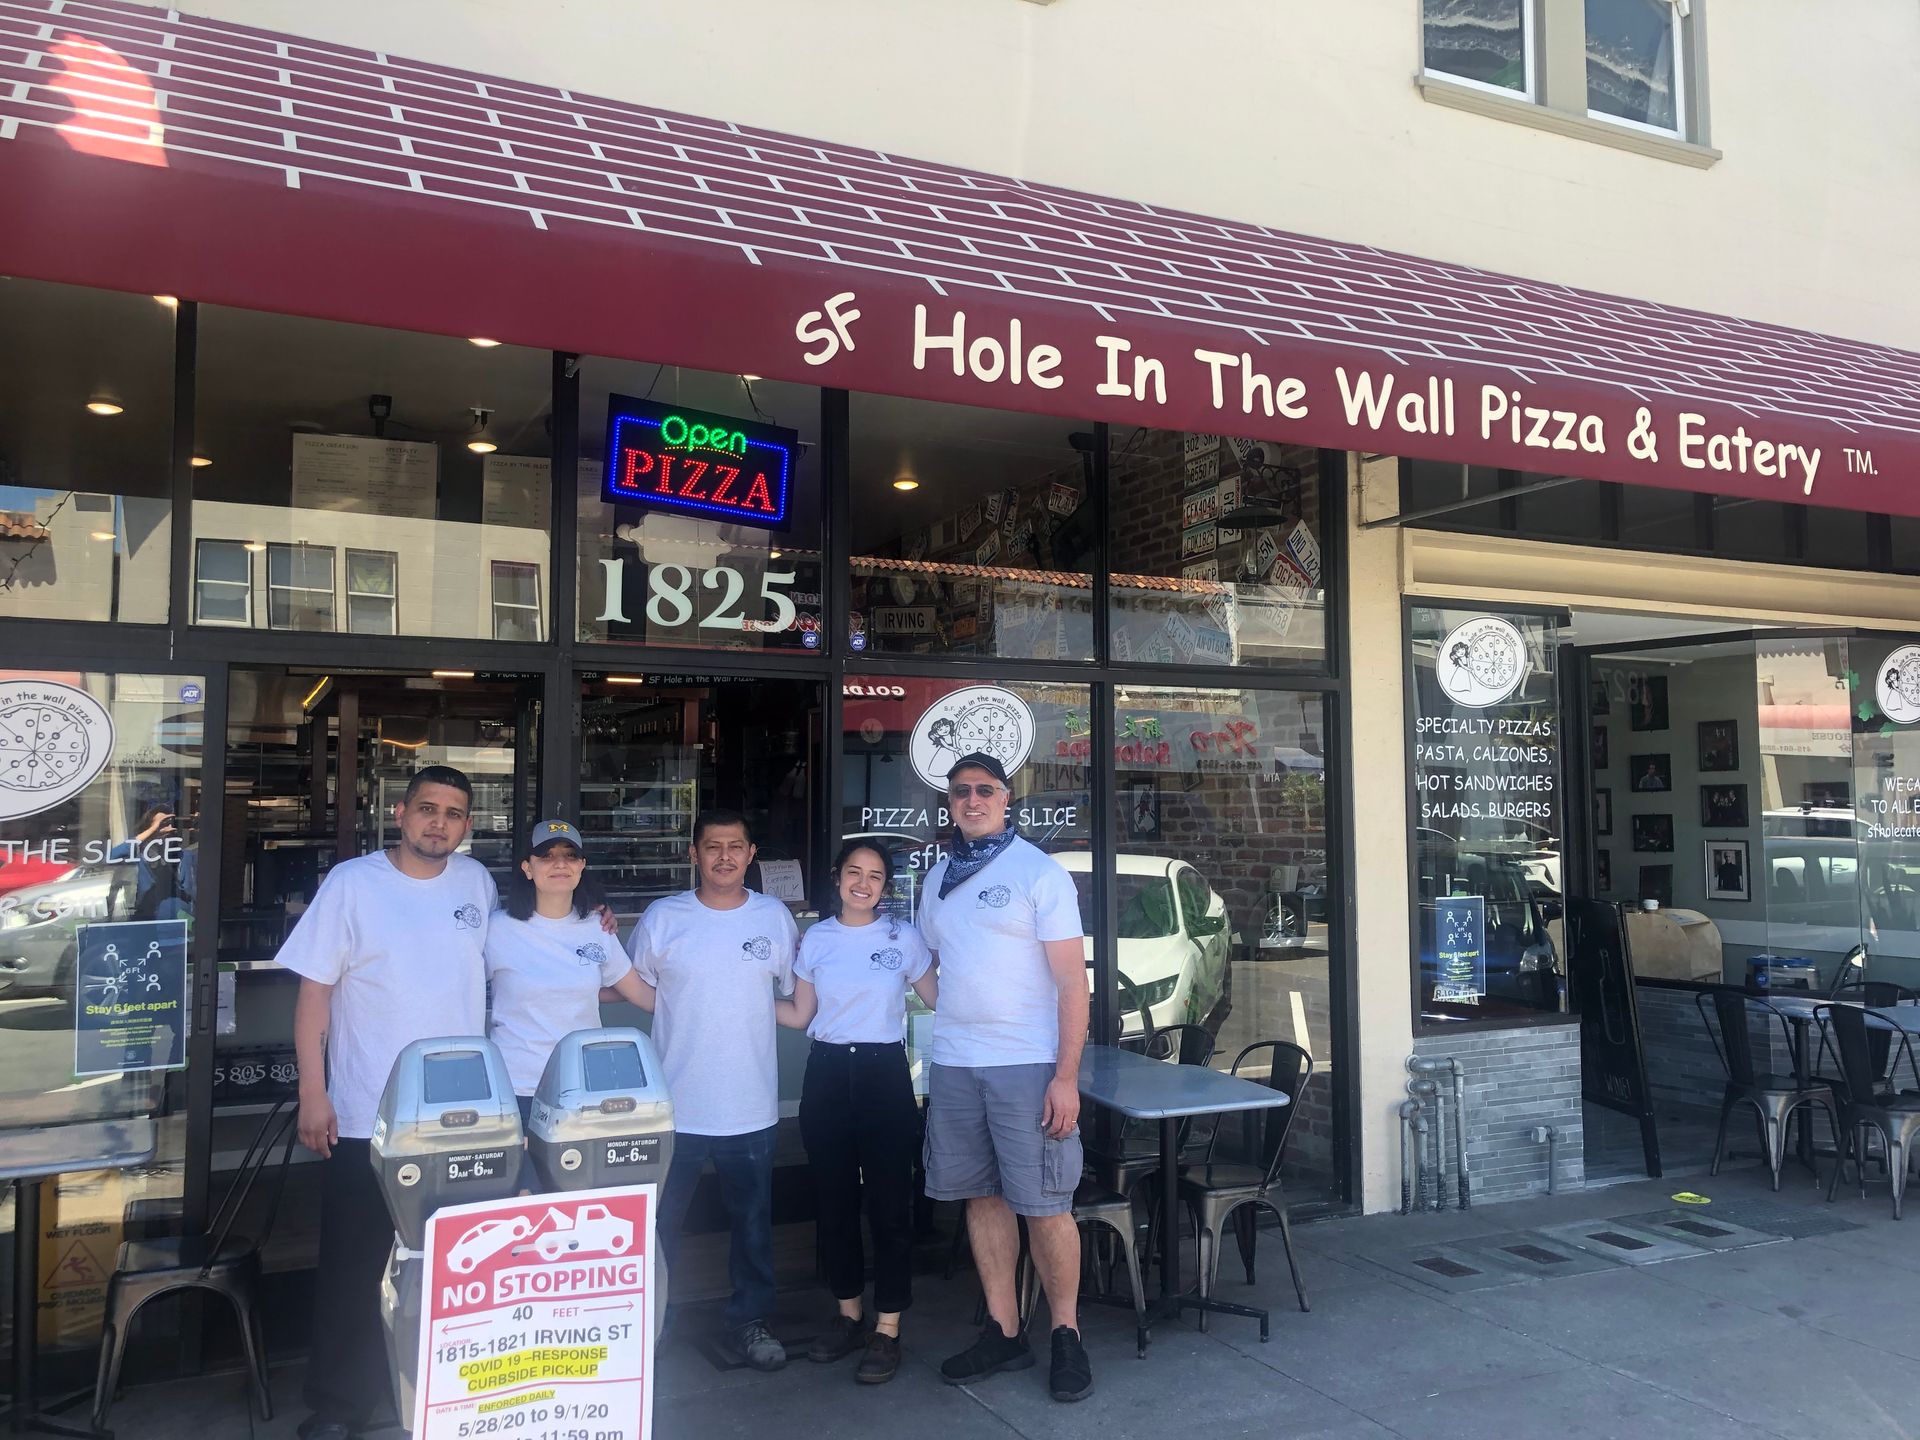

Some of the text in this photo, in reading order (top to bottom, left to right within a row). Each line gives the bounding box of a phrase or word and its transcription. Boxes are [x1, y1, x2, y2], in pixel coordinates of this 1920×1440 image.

[795, 291, 860, 366] SF
[912, 303, 1064, 390] Hole
[1095, 335, 1167, 405] In
[1193, 348, 1309, 419] The
[1335, 366, 1455, 436] Wall
[1480, 384, 1606, 454] Pizza
[1626, 406, 1659, 463] &
[1679, 412, 1822, 495] Eatery
[660, 415, 747, 453] Open
[621, 448, 776, 512] PIZZA
[595, 557, 797, 633] 1825
[884, 612, 925, 629] IRVING
[664, 676, 682, 684] Hole
[685, 676, 693, 684] in
[183, 690, 199, 698] ADT
[17, 692, 37, 701] the
[43, 694, 67, 705] wall
[67, 703, 93, 726] pizza
[953, 705, 968, 719] hole
[992, 697, 1006, 705] wall
[1006, 703, 1022, 720] pizza
[1416, 717, 1551, 737] SPECIALTY PIZZAS
[1416, 744, 1552, 765] PASTA, CALZONES,
[1417, 774, 1553, 792] HOT SANDWICHES
[1885, 776, 1904, 792] WE
[862, 807, 929, 828] PIZZA
[1018, 806, 1077, 827] SLICE
[1421, 802, 1551, 820] SALADS, BURGERS
[1871, 799, 1888, 814] TO
[1891, 799, 1912, 814] ALL
[0, 837, 183, 865] THE SLICE
[132, 966, 140, 974] Ft
[86, 1000, 177, 1015] Stay 6 feet apart
[229, 1064, 265, 1082] 805
[442, 1263, 638, 1309] NO STOPPING
[512, 1305, 580, 1321] 40 FEET
[436, 1323, 633, 1364] 1815-1821 IRVING ST
[459, 1358, 503, 1377] COVID
[507, 1355, 521, 1367] 19
[467, 1364, 598, 1391] CURBSIDE PICK-UP
[478, 1396, 528, 1413] ENFORCED
[530, 1389, 556, 1403] DAILY
[458, 1404, 609, 1438] 5/28/20 to 9/1/20
